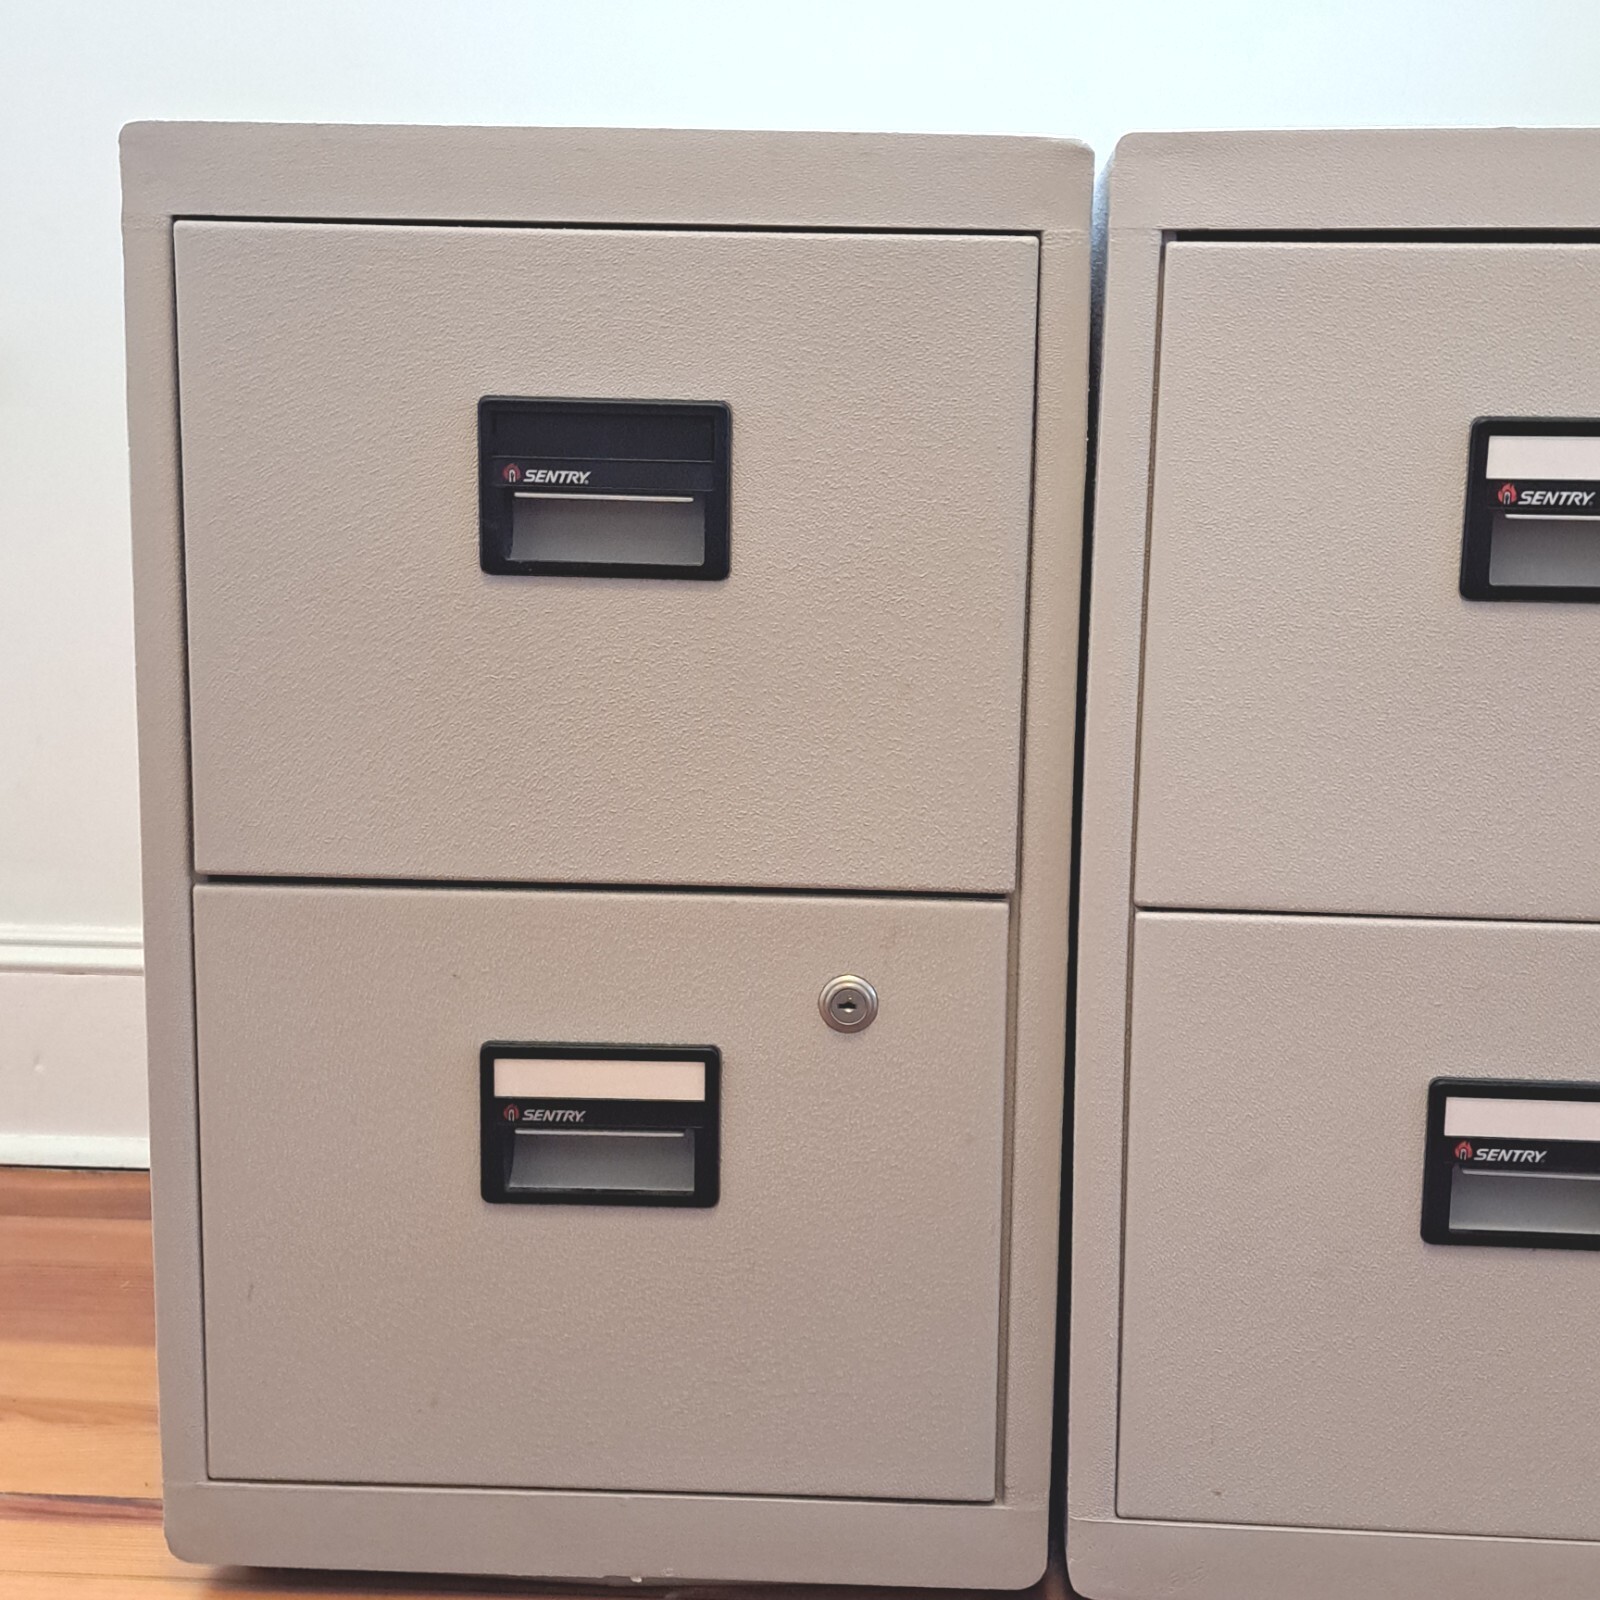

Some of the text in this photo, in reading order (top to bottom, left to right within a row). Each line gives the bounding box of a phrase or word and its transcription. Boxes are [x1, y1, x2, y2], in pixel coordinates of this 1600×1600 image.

[523, 469, 591, 485] SENTRY
[1518, 490, 1596, 506] SENTRY
[522, 1109, 586, 1123] SENTRY
[1474, 1148, 1547, 1163] SENTRY
